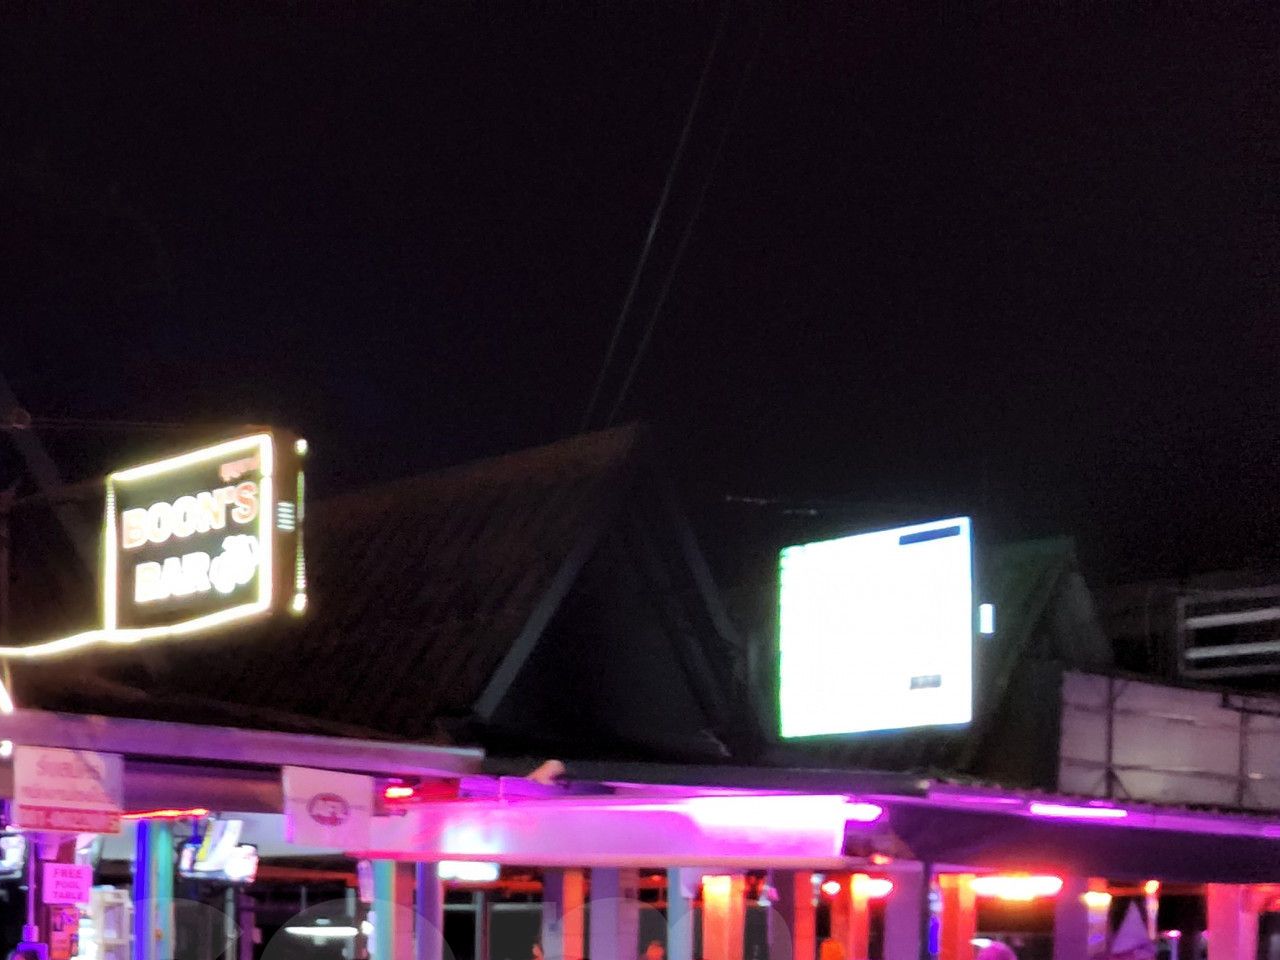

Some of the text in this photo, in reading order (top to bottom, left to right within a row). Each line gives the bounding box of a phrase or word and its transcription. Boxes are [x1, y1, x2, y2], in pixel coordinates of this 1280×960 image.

[134, 552, 212, 602] BAR
[53, 868, 83, 879] FREE
[55, 880, 81, 890] POOL
[53, 891, 83, 900] TABLE
